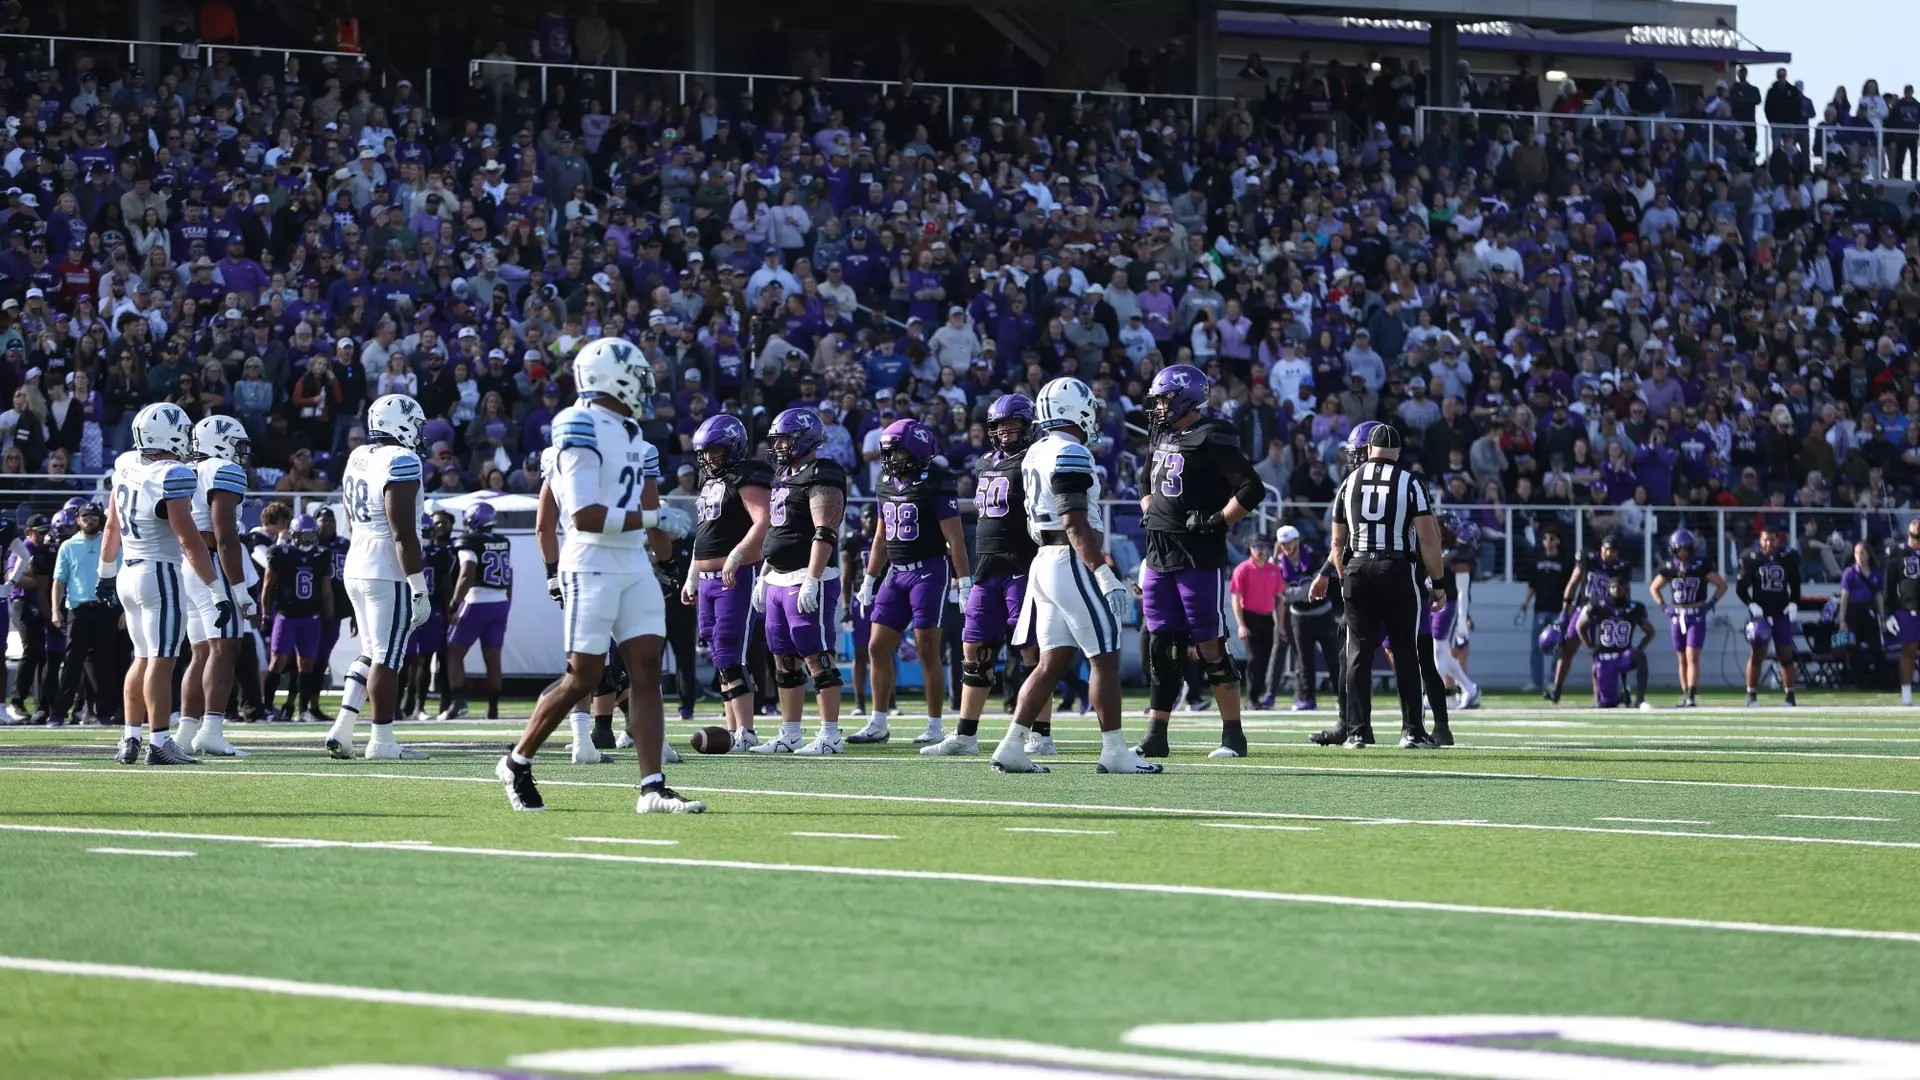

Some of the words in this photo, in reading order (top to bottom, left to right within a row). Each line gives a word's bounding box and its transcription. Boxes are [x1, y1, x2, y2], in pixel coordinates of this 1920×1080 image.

[1150, 450, 1185, 497] 73
[1361, 484, 1390, 521] U
[882, 502, 919, 541] 88
[296, 570, 313, 599] 6
[1671, 577, 1700, 604] 37
[1759, 565, 1785, 592] 12
[1600, 619, 1632, 648] 39
